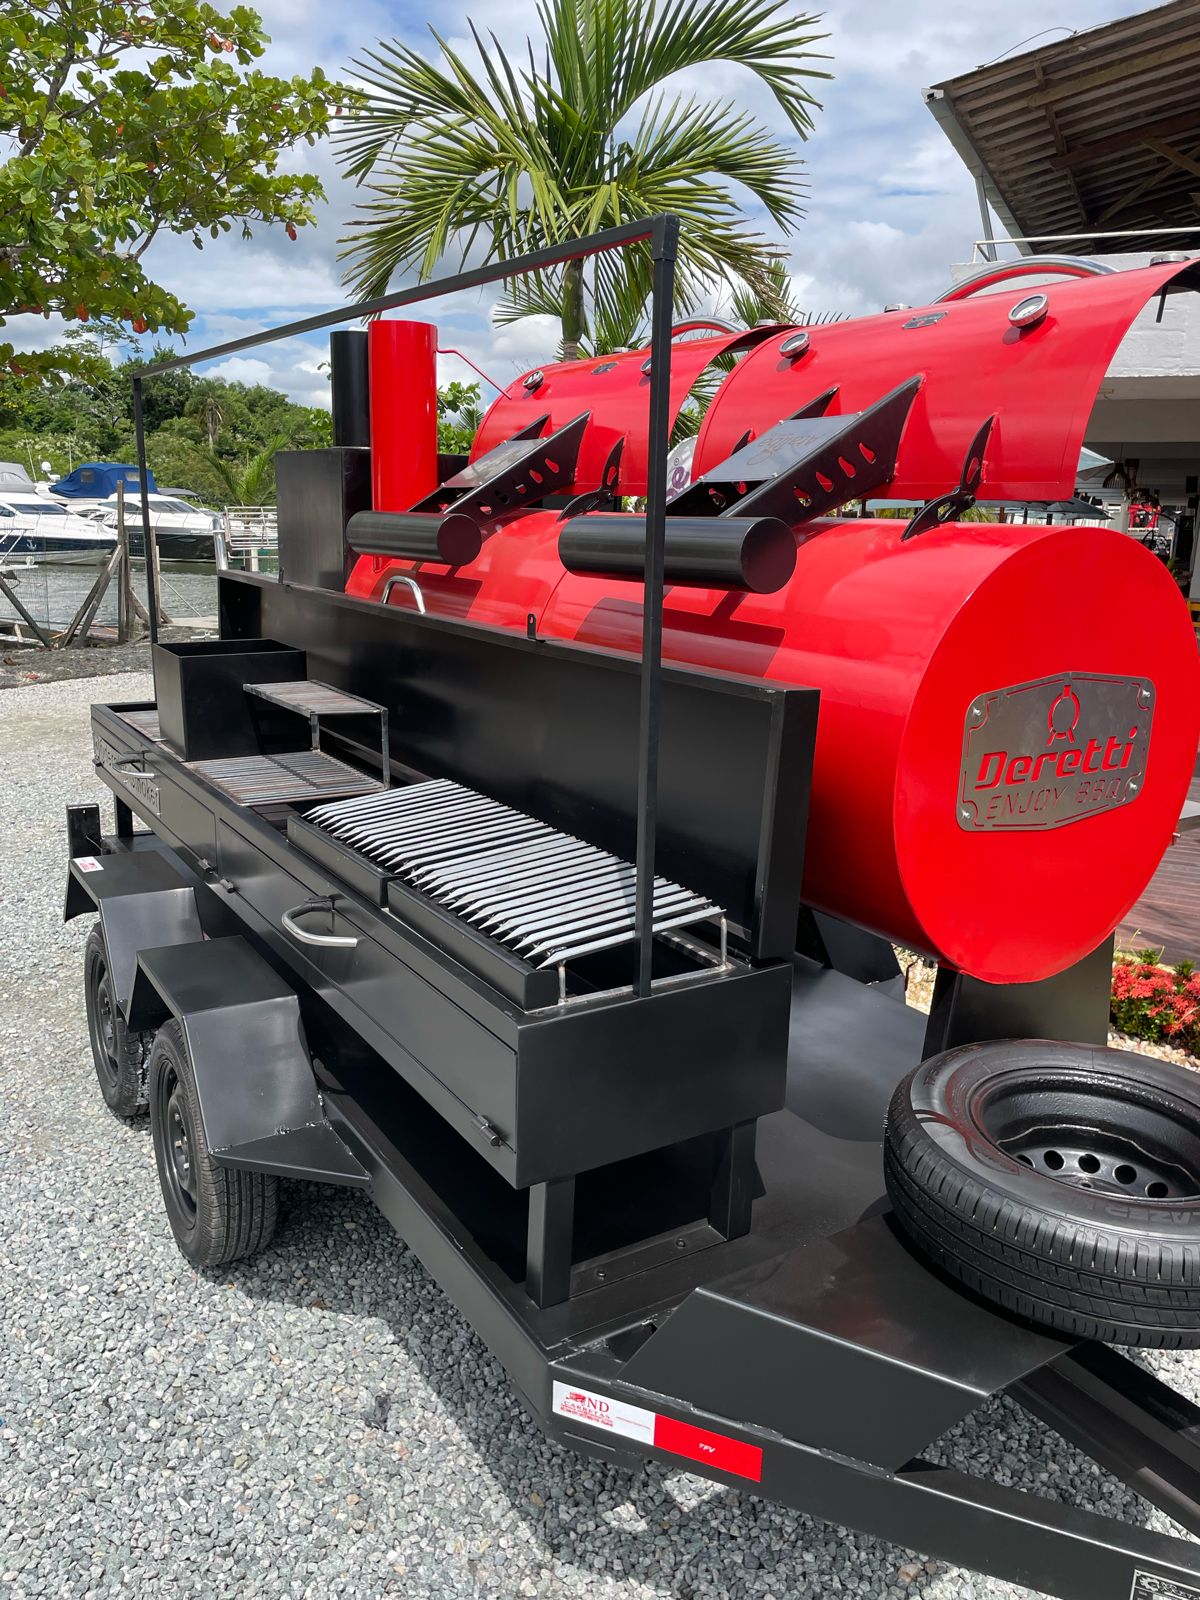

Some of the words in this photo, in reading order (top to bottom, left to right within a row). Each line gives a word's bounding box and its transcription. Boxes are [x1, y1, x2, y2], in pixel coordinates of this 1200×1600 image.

[975, 726, 1138, 791] Deretti
[986, 785, 1072, 820] ENJOY
[1075, 777, 1122, 804] BBQ
[587, 1397, 610, 1413] ND
